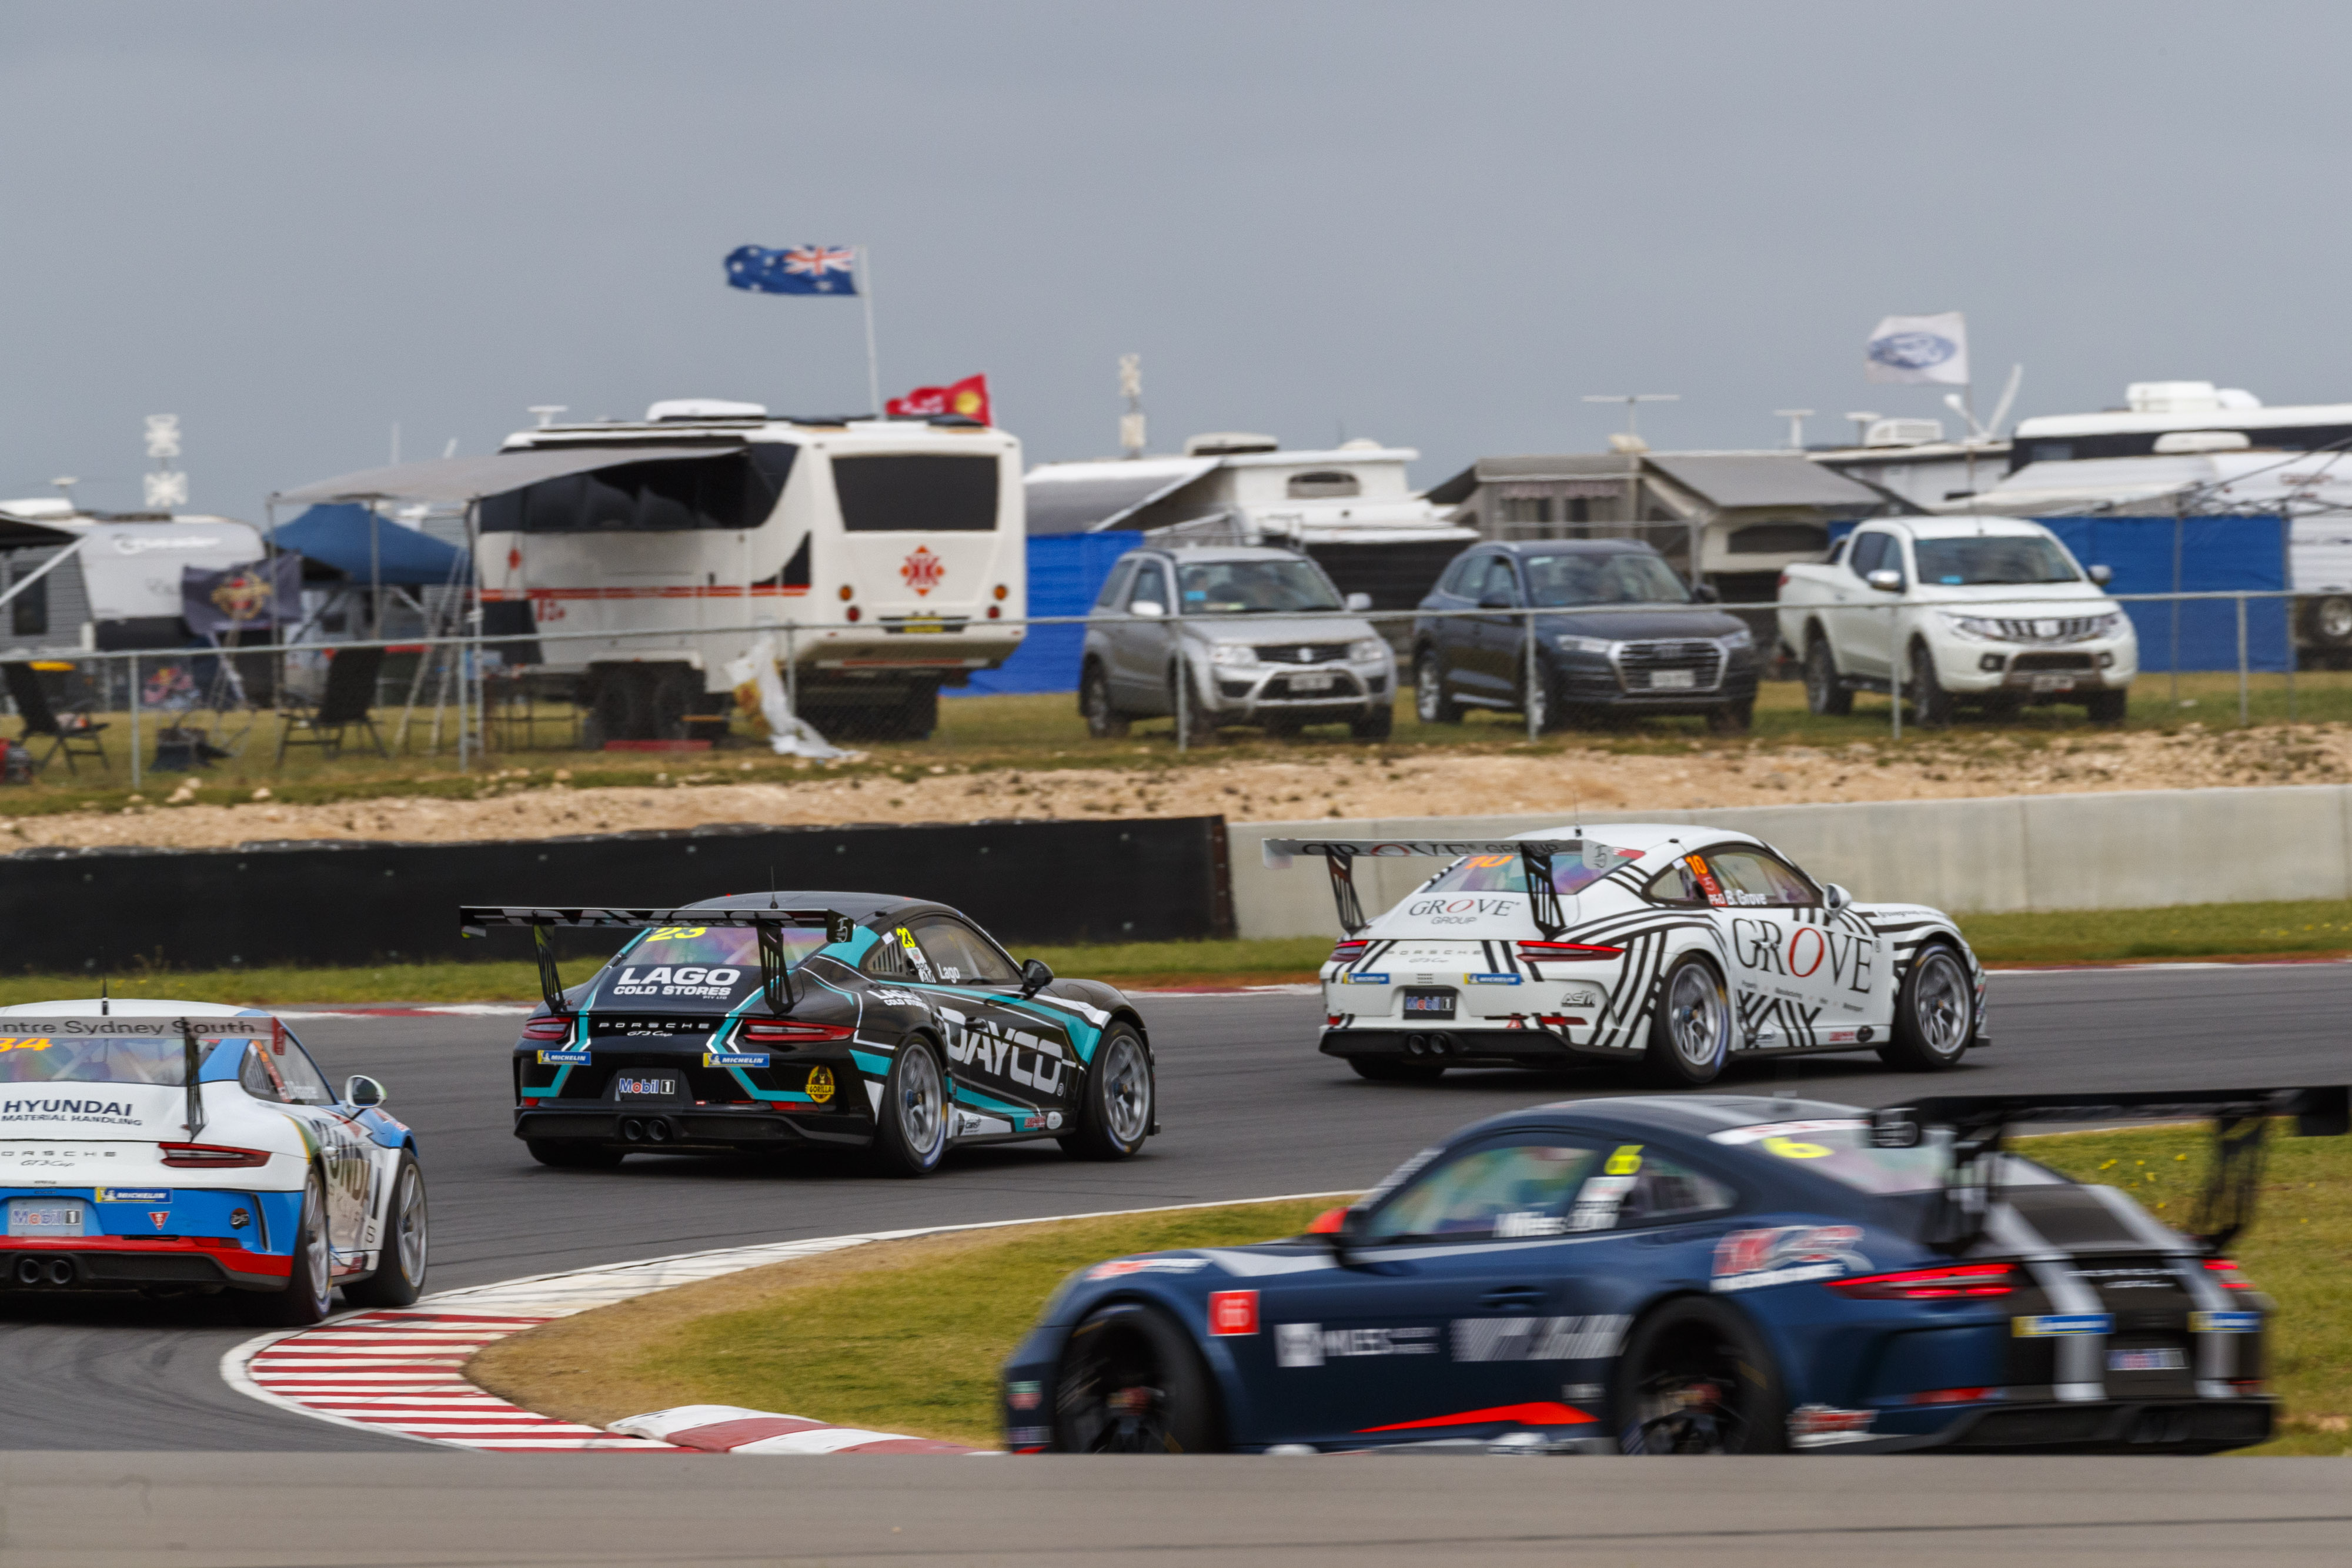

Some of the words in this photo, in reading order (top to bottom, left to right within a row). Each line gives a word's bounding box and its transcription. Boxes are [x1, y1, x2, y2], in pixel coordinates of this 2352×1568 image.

[1685, 855, 1708, 875] 10
[1724, 890, 1737, 905] B.
[1736, 889, 1768, 905] Grove
[1409, 899, 1515, 916] GROVE
[1431, 916, 1476, 925] GROUP
[646, 927, 707, 942] 23
[896, 927, 916, 948] 23
[1732, 918, 1873, 994] GROVE
[618, 967, 741, 986] LAGO
[937, 962, 960, 984] Lago
[613, 986, 658, 995] COLD
[662, 986, 731, 996] STORES
[0, 1021, 57, 1034] ntre
[64, 1021, 165, 1035] Sydney
[172, 1020, 255, 1034] South
[939, 1006, 1065, 1095] DAYCO
[619, 1078, 660, 1094] Mobil
[4, 1099, 133, 1116] HYUNDAI
[1, 1114, 68, 1122] MATERIAL
[71, 1115, 143, 1126] HANDLING
[1603, 1145, 1645, 1175] 6
[11, 1209, 66, 1225] Mobil
